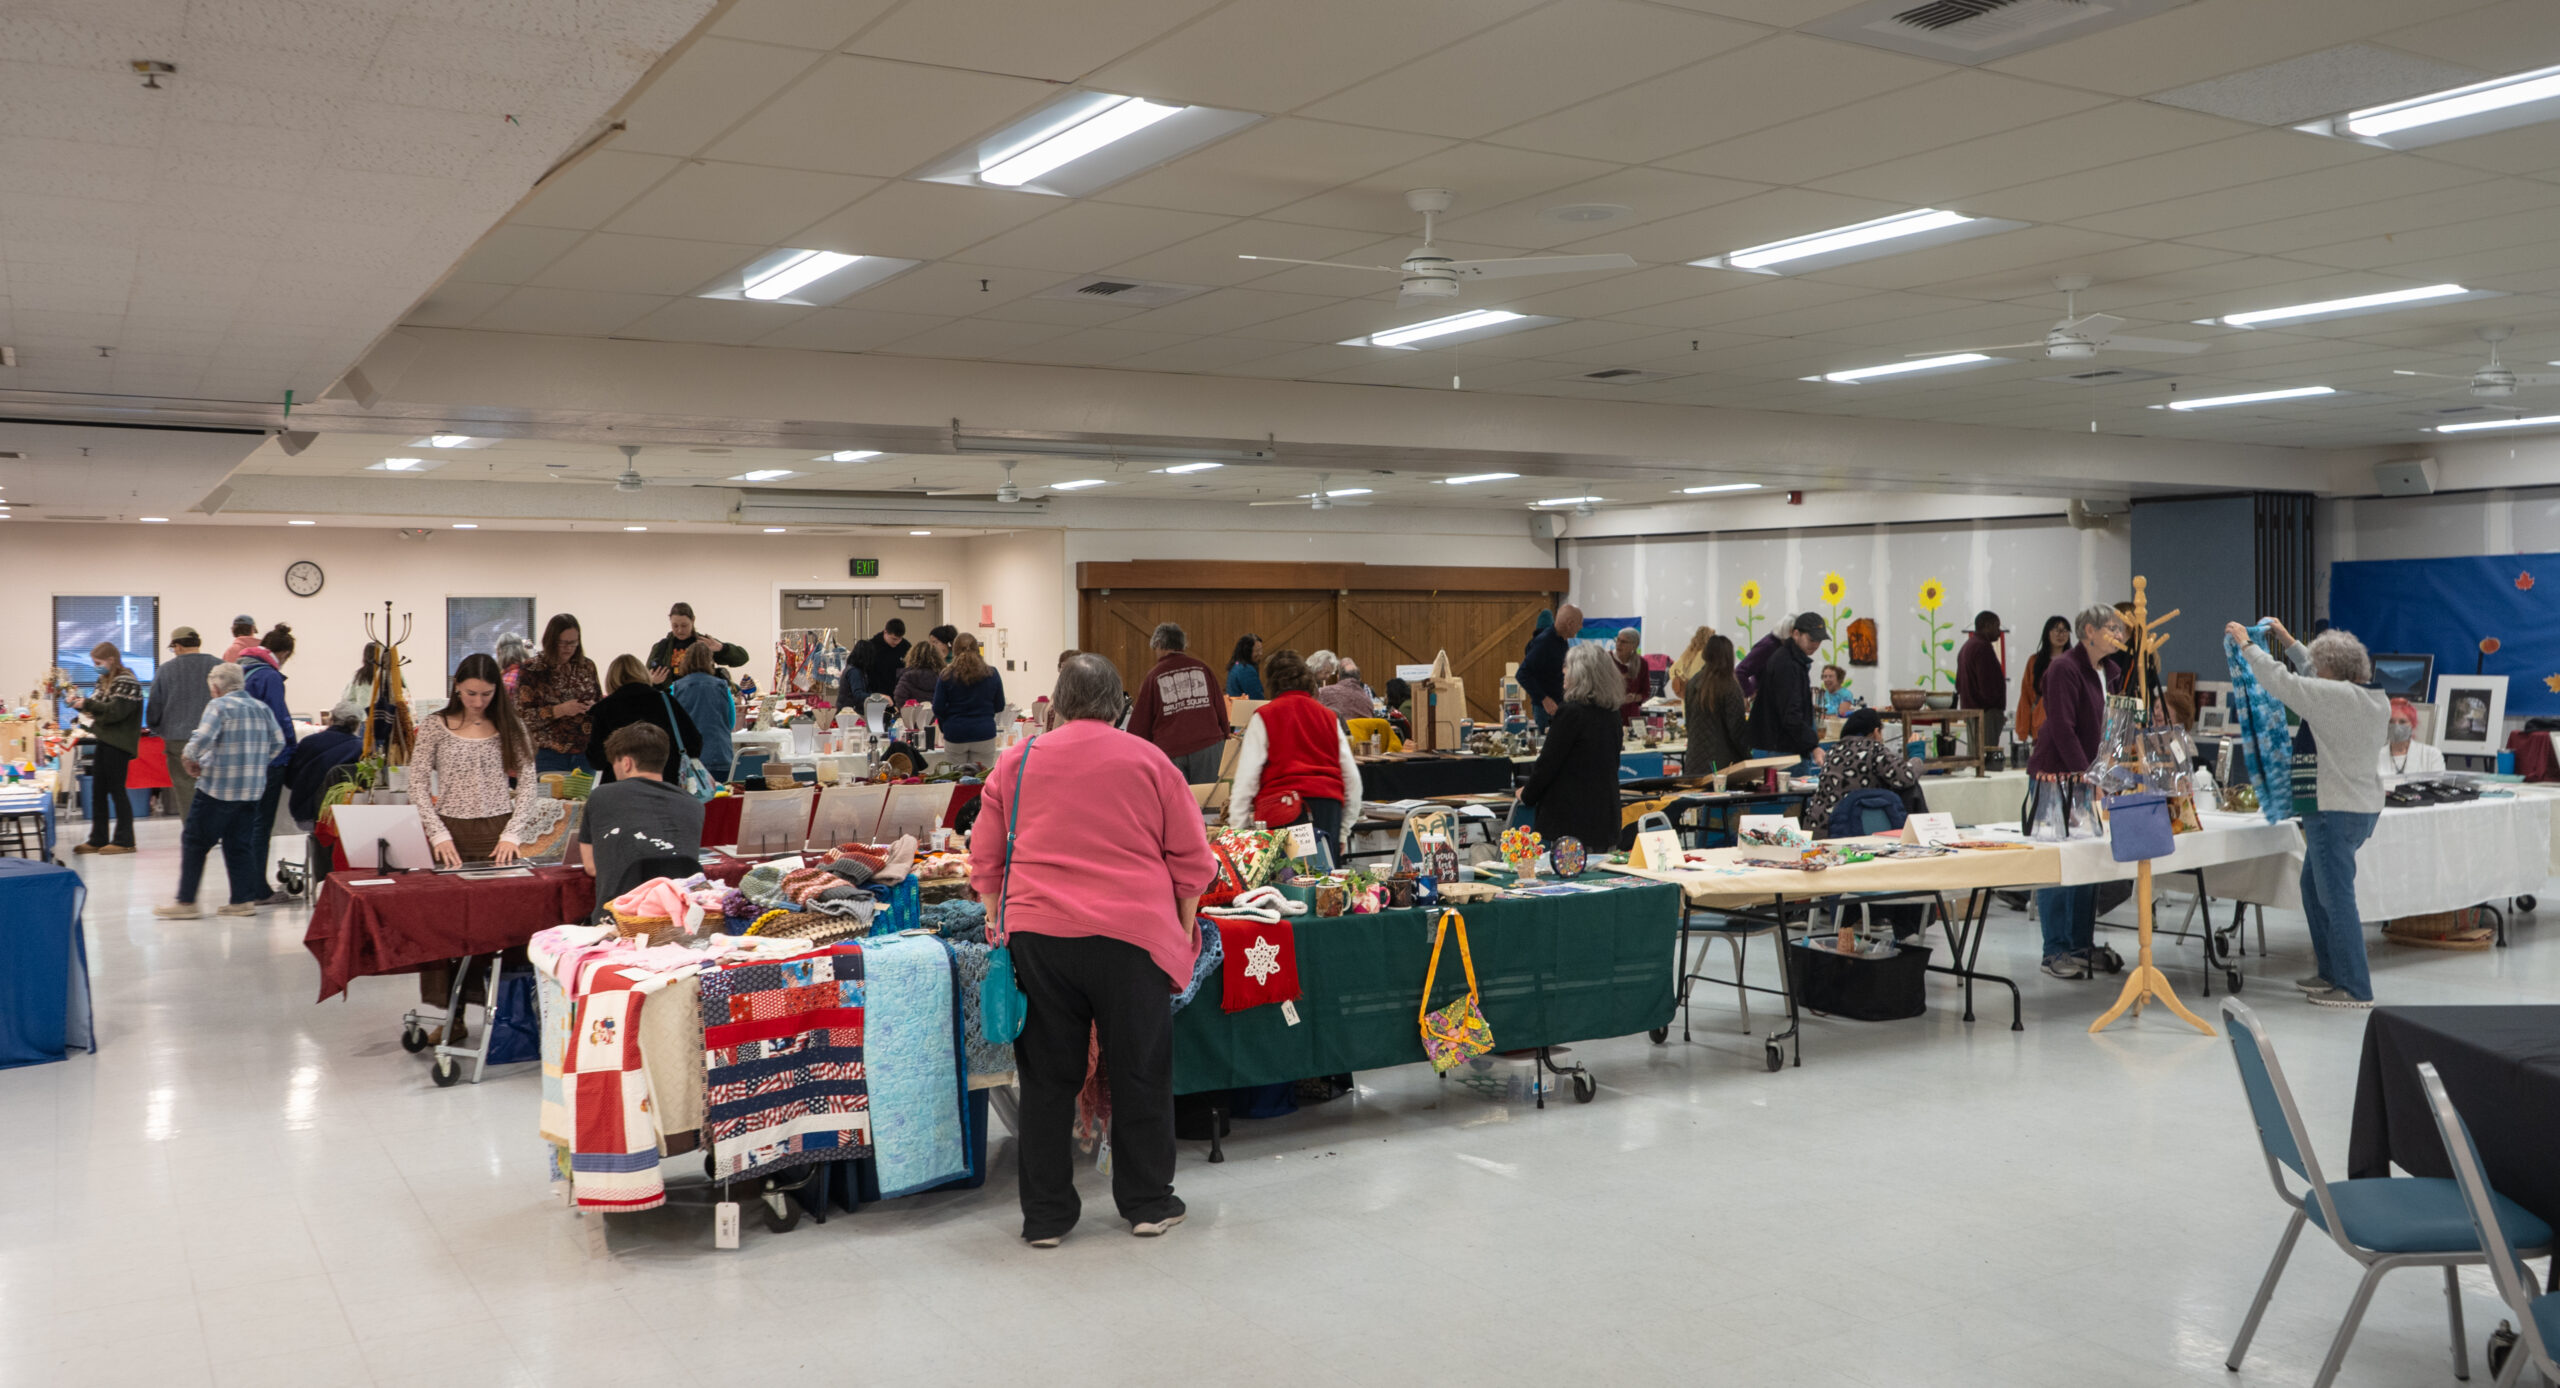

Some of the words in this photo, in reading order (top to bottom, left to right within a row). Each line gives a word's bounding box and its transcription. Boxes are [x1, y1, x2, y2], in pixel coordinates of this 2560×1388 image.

[856, 560, 876, 575] EXIT
[1163, 700, 1185, 712] BRUTE
[1186, 697, 1210, 706] SQUAD
